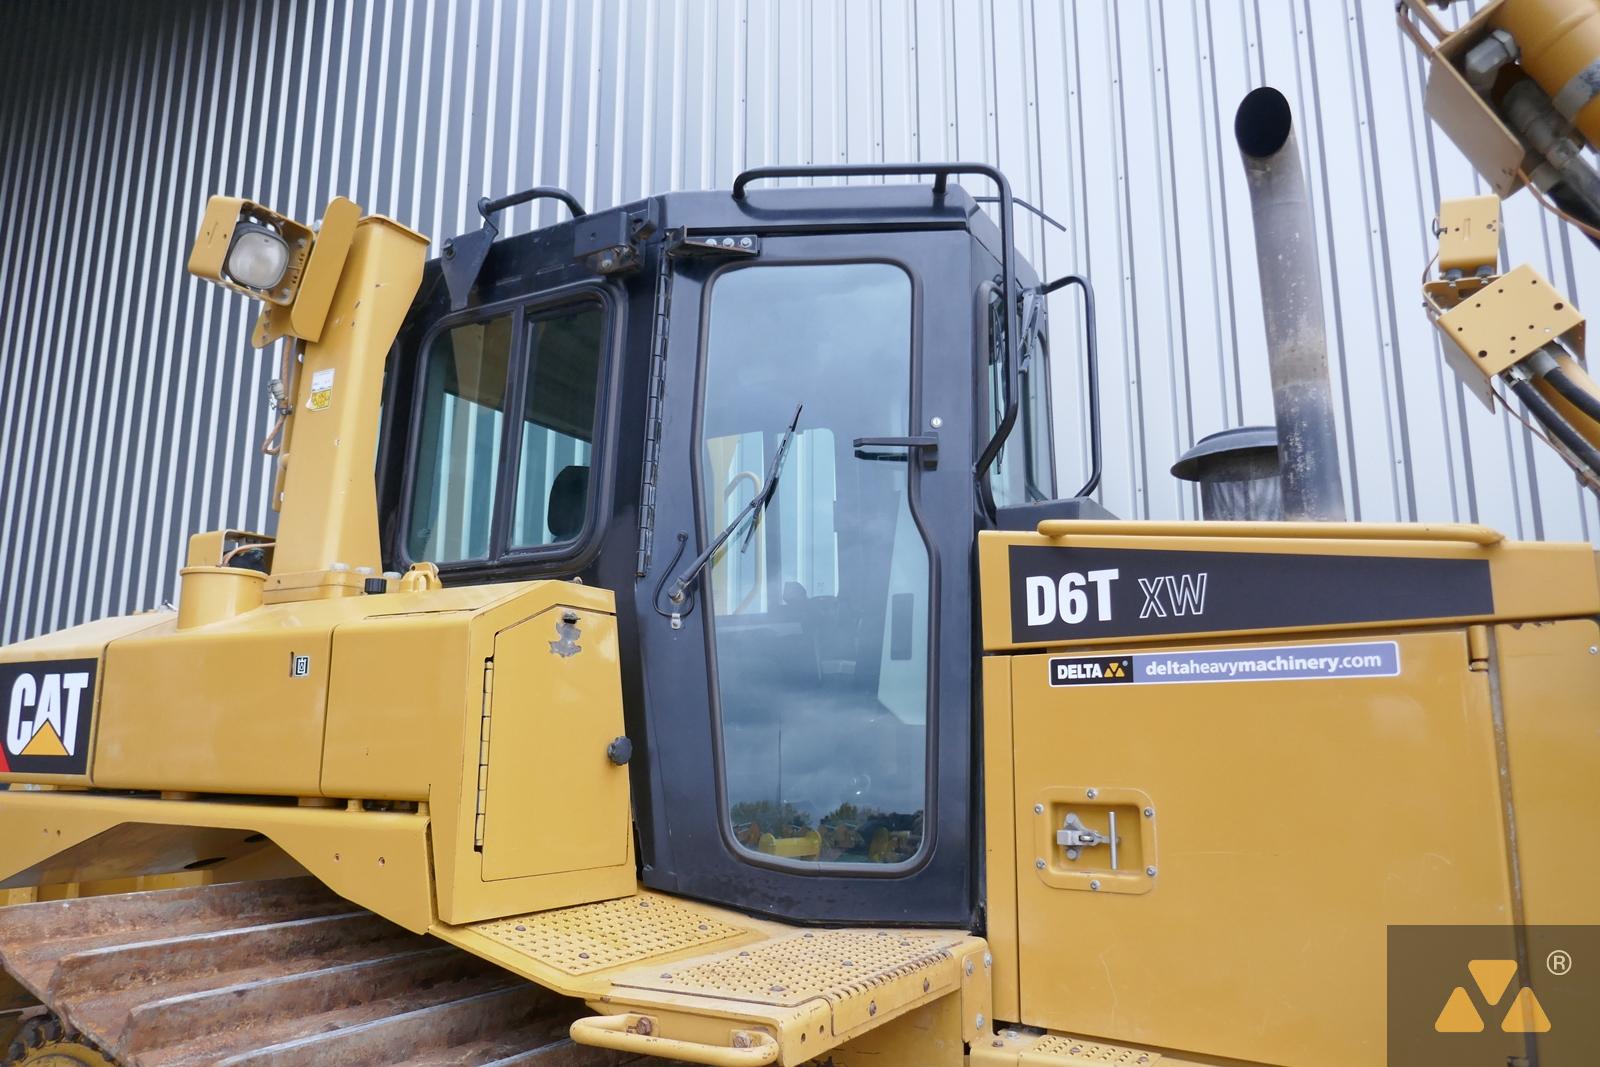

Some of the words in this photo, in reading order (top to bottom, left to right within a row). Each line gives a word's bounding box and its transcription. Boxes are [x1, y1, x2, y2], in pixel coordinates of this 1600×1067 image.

[1025, 568, 1120, 627] D6T
[1137, 573, 1208, 619] XW
[1056, 662, 1103, 680] DELTA
[1144, 653, 1383, 677] deltaheavymachinery.com
[6, 672, 89, 756] CAT
